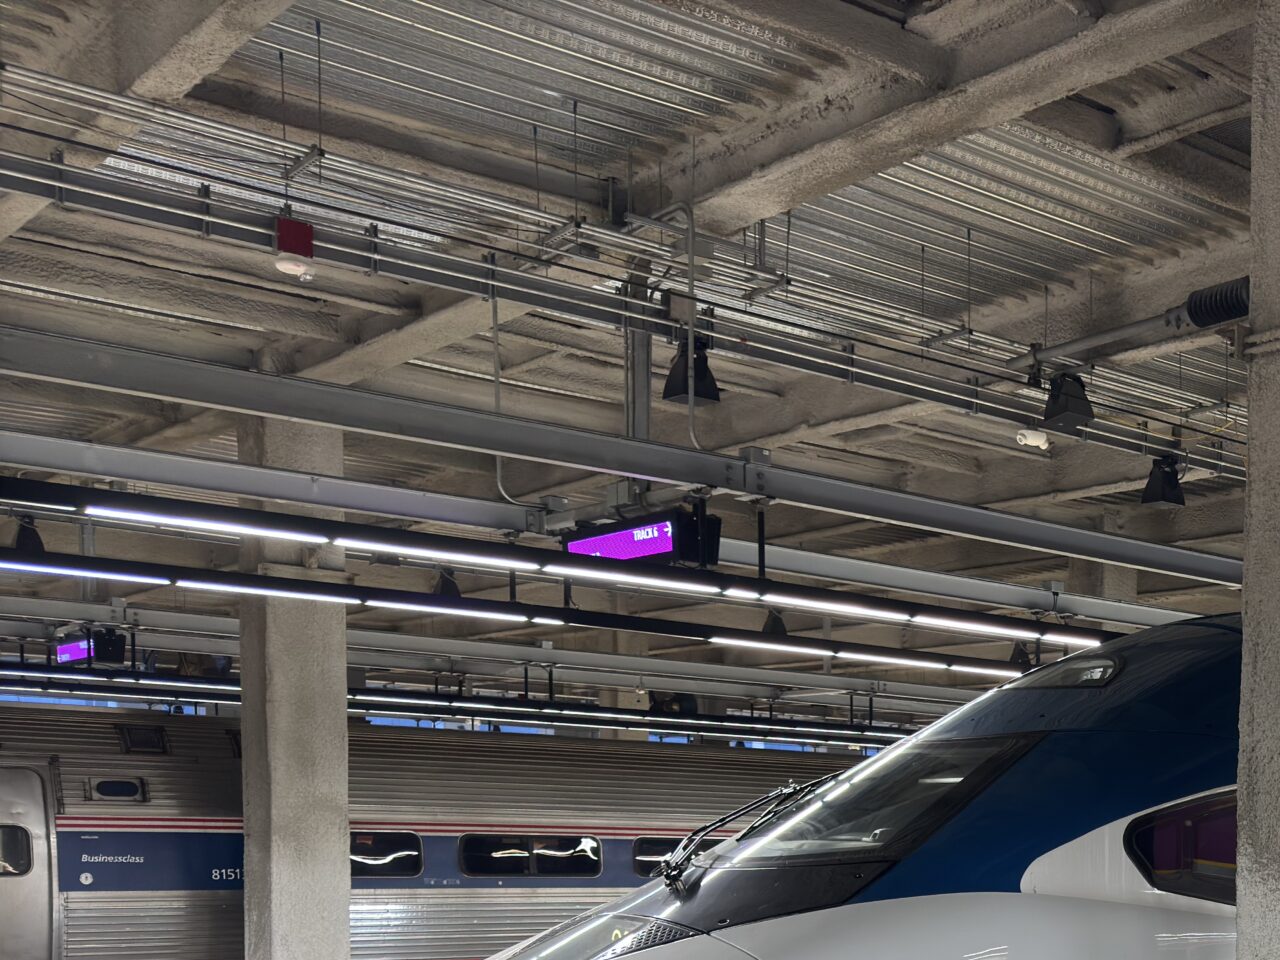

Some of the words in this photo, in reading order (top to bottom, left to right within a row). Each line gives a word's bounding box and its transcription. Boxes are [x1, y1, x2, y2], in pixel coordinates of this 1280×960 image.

[633, 528, 653, 541] TRACK
[81, 854, 144, 863] Businessclass
[212, 869, 244, 880] 8151
